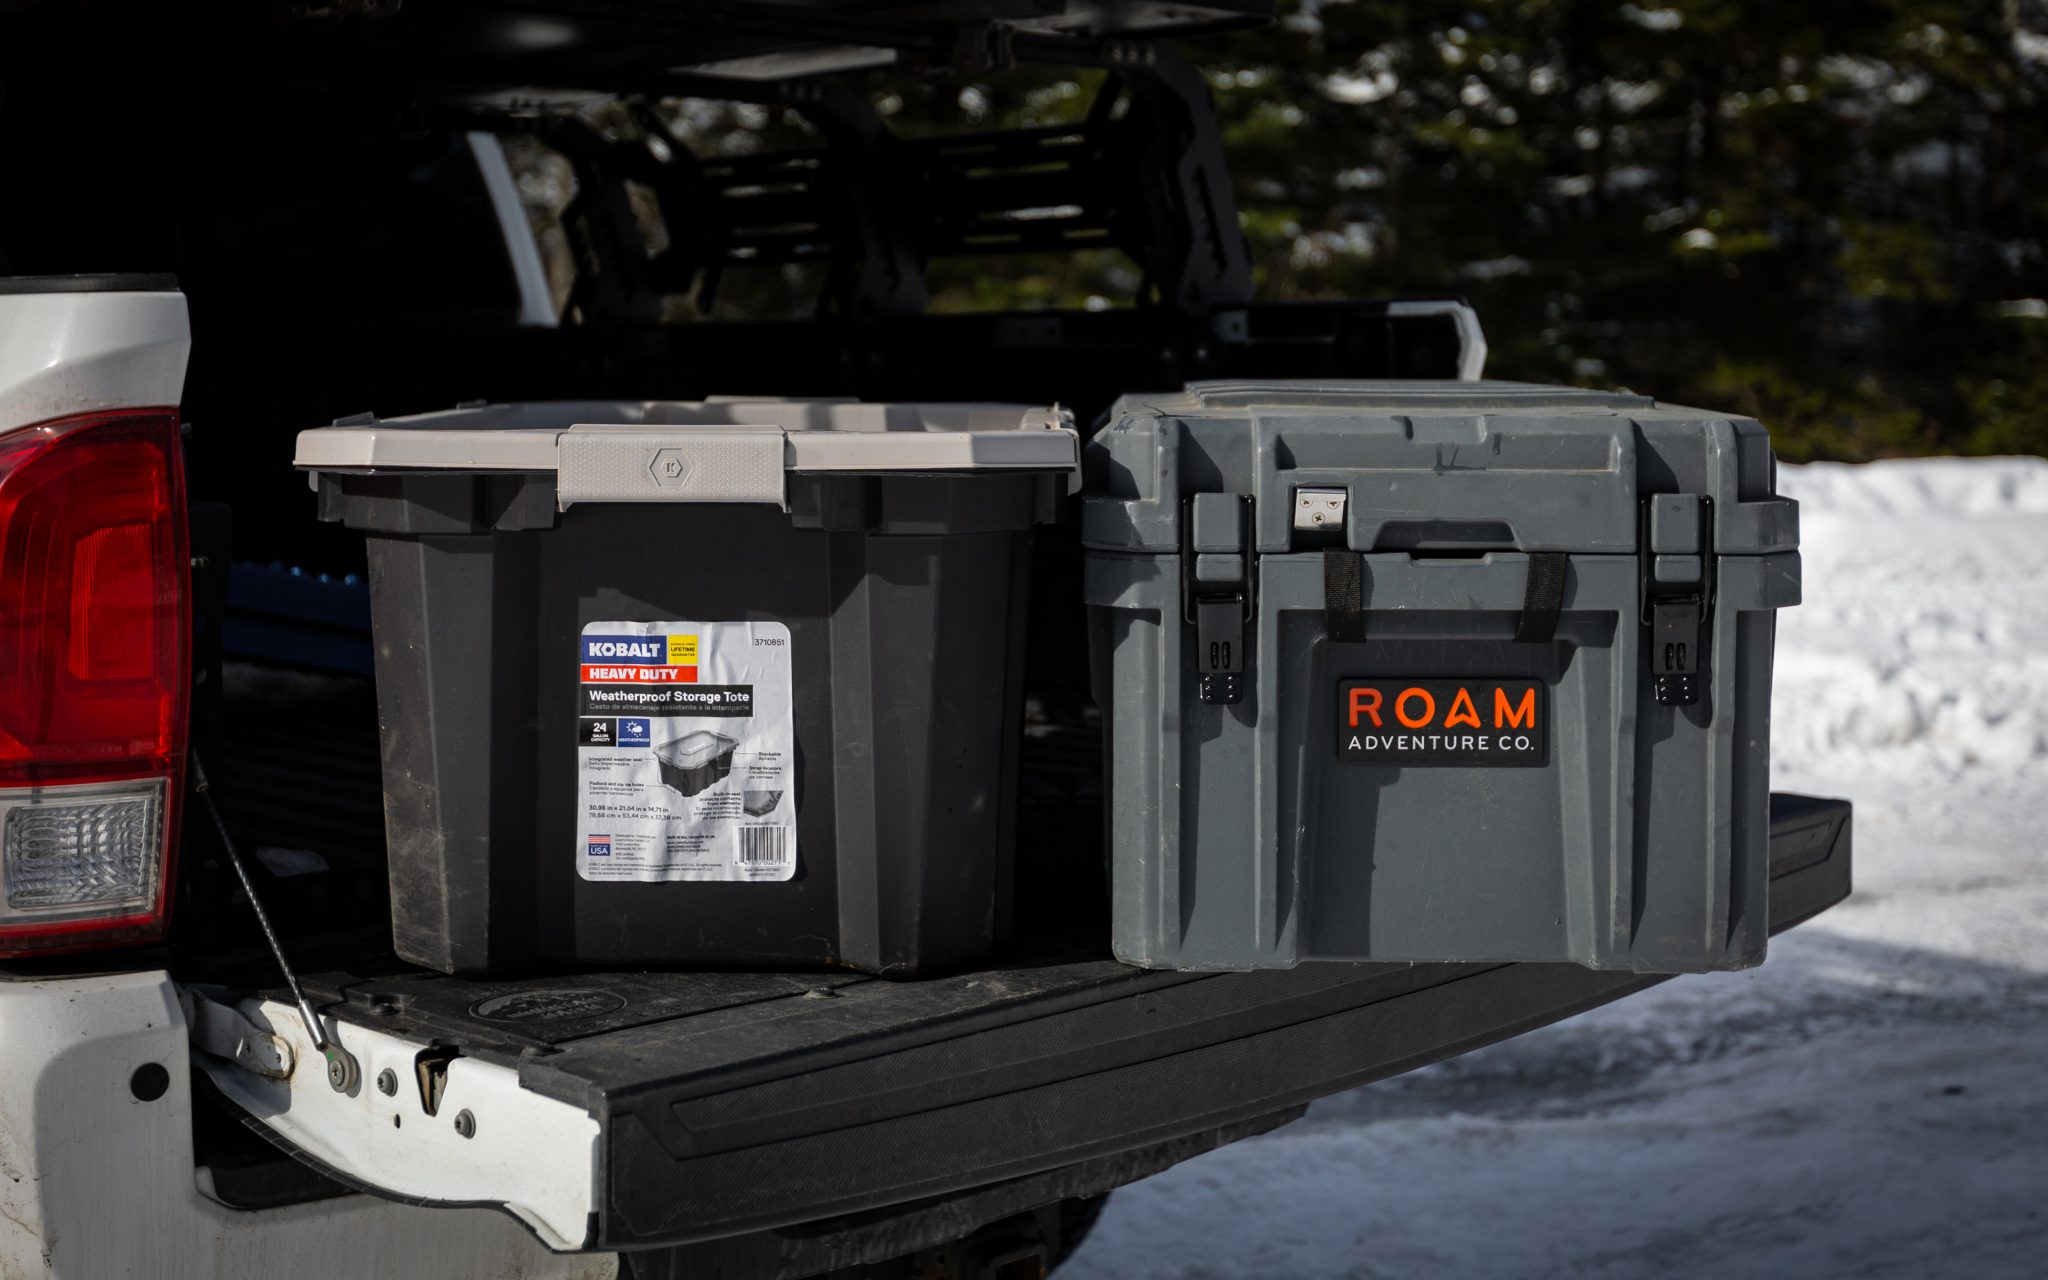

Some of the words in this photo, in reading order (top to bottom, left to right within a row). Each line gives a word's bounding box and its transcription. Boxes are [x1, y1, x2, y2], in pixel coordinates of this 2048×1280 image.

[588, 642, 660, 658] KOBALT
[589, 668, 637, 680] HEAVY
[640, 668, 678, 680] DUTY
[589, 690, 672, 704] Weatherproof
[674, 691, 720, 704] Storage
[723, 692, 750, 702] Tote
[622, 704, 660, 712] almacenaje
[1348, 687, 1535, 729] ROAM
[593, 722, 607, 732] 24
[1348, 736, 1490, 750] ADVENTURE
[1498, 736, 1534, 750] CO.
